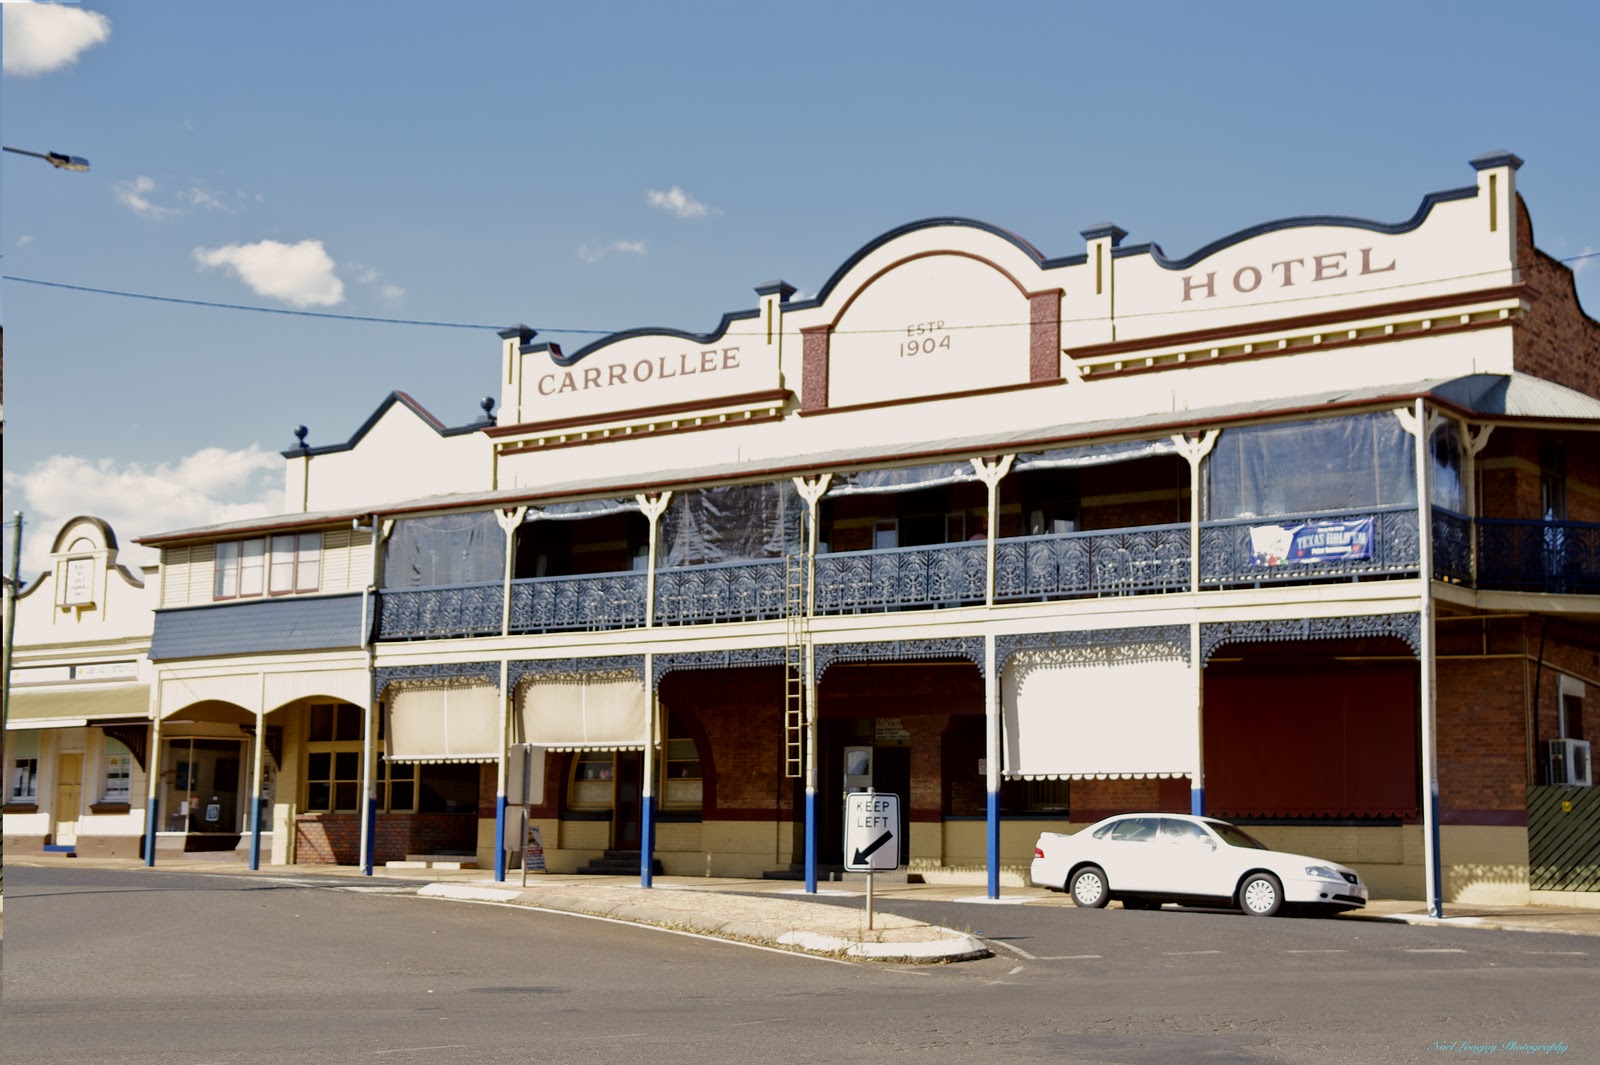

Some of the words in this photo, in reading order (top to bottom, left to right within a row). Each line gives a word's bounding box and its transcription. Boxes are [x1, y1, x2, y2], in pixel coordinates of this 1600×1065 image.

[1181, 247, 1396, 302] HOTEL
[900, 334, 950, 357] 1904
[537, 347, 740, 396] CARROLLEE
[1297, 532, 1325, 549] TEXAS
[857, 801, 890, 812] KEEP
[857, 816, 889, 828] LEFT
